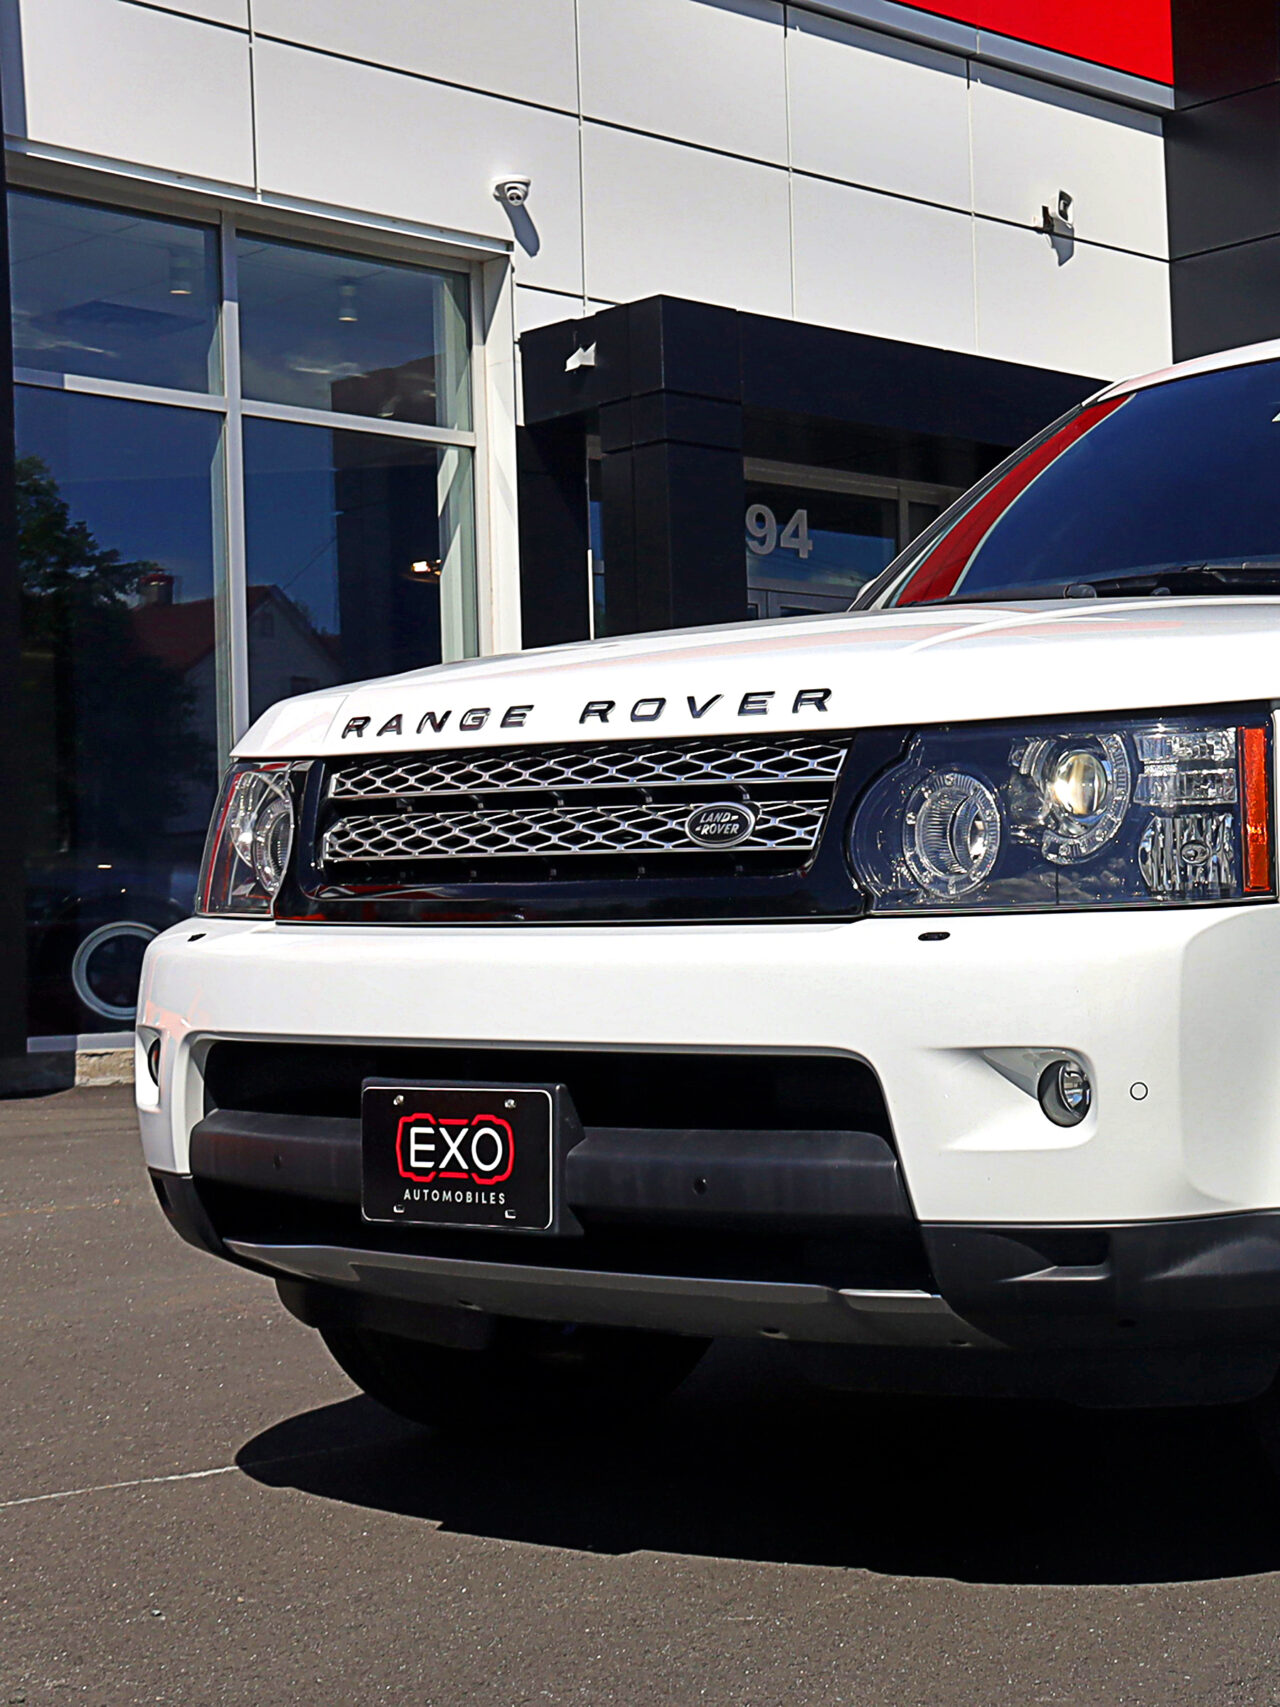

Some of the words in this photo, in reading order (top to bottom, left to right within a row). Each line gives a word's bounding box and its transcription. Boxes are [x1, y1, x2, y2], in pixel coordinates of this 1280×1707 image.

[745, 504, 813, 559] 94
[341, 704, 534, 739] RANGE
[579, 688, 833, 725] ROVER
[409, 1126, 503, 1172] EXO
[403, 1189, 506, 1205] AUTOMOBILES
